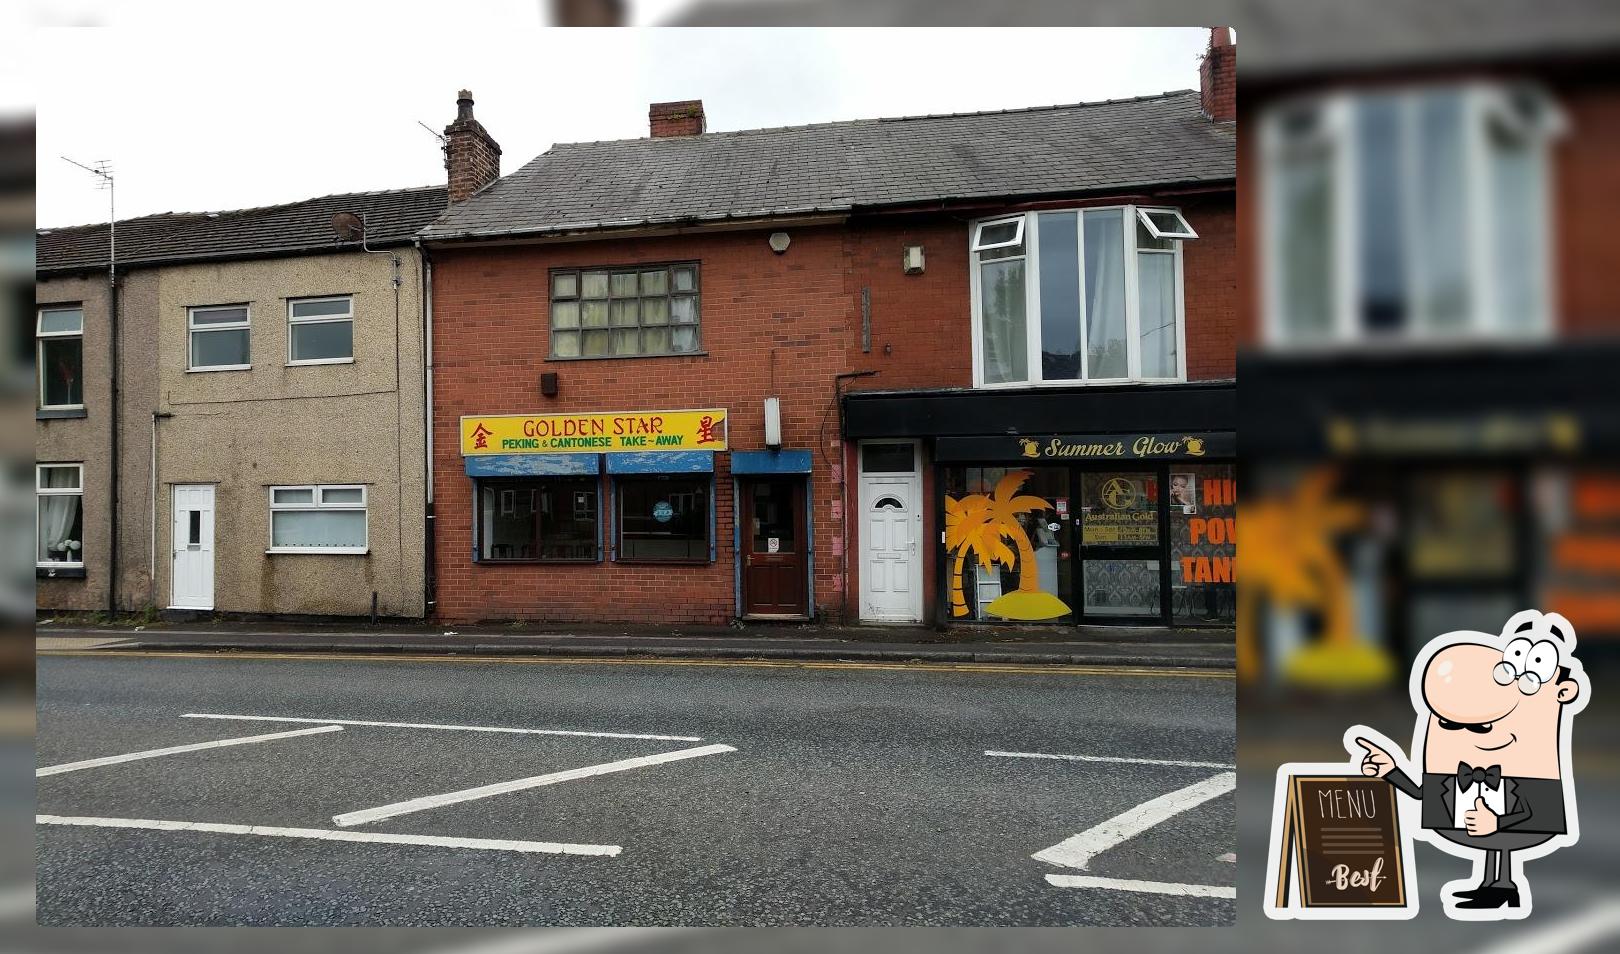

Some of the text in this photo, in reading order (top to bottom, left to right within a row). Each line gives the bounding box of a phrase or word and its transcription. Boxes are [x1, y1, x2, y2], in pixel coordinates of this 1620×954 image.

[470, 422, 493, 449] 金
[523, 416, 663, 437] GOLDEN STAR
[502, 438, 539, 449] PEKING
[541, 439, 548, 448] &
[550, 436, 612, 448] CANTONESE
[1045, 436, 1183, 458] Summer Glow
[1203, 479, 1237, 506] HI
[1086, 512, 1154, 521] Australian Gold
